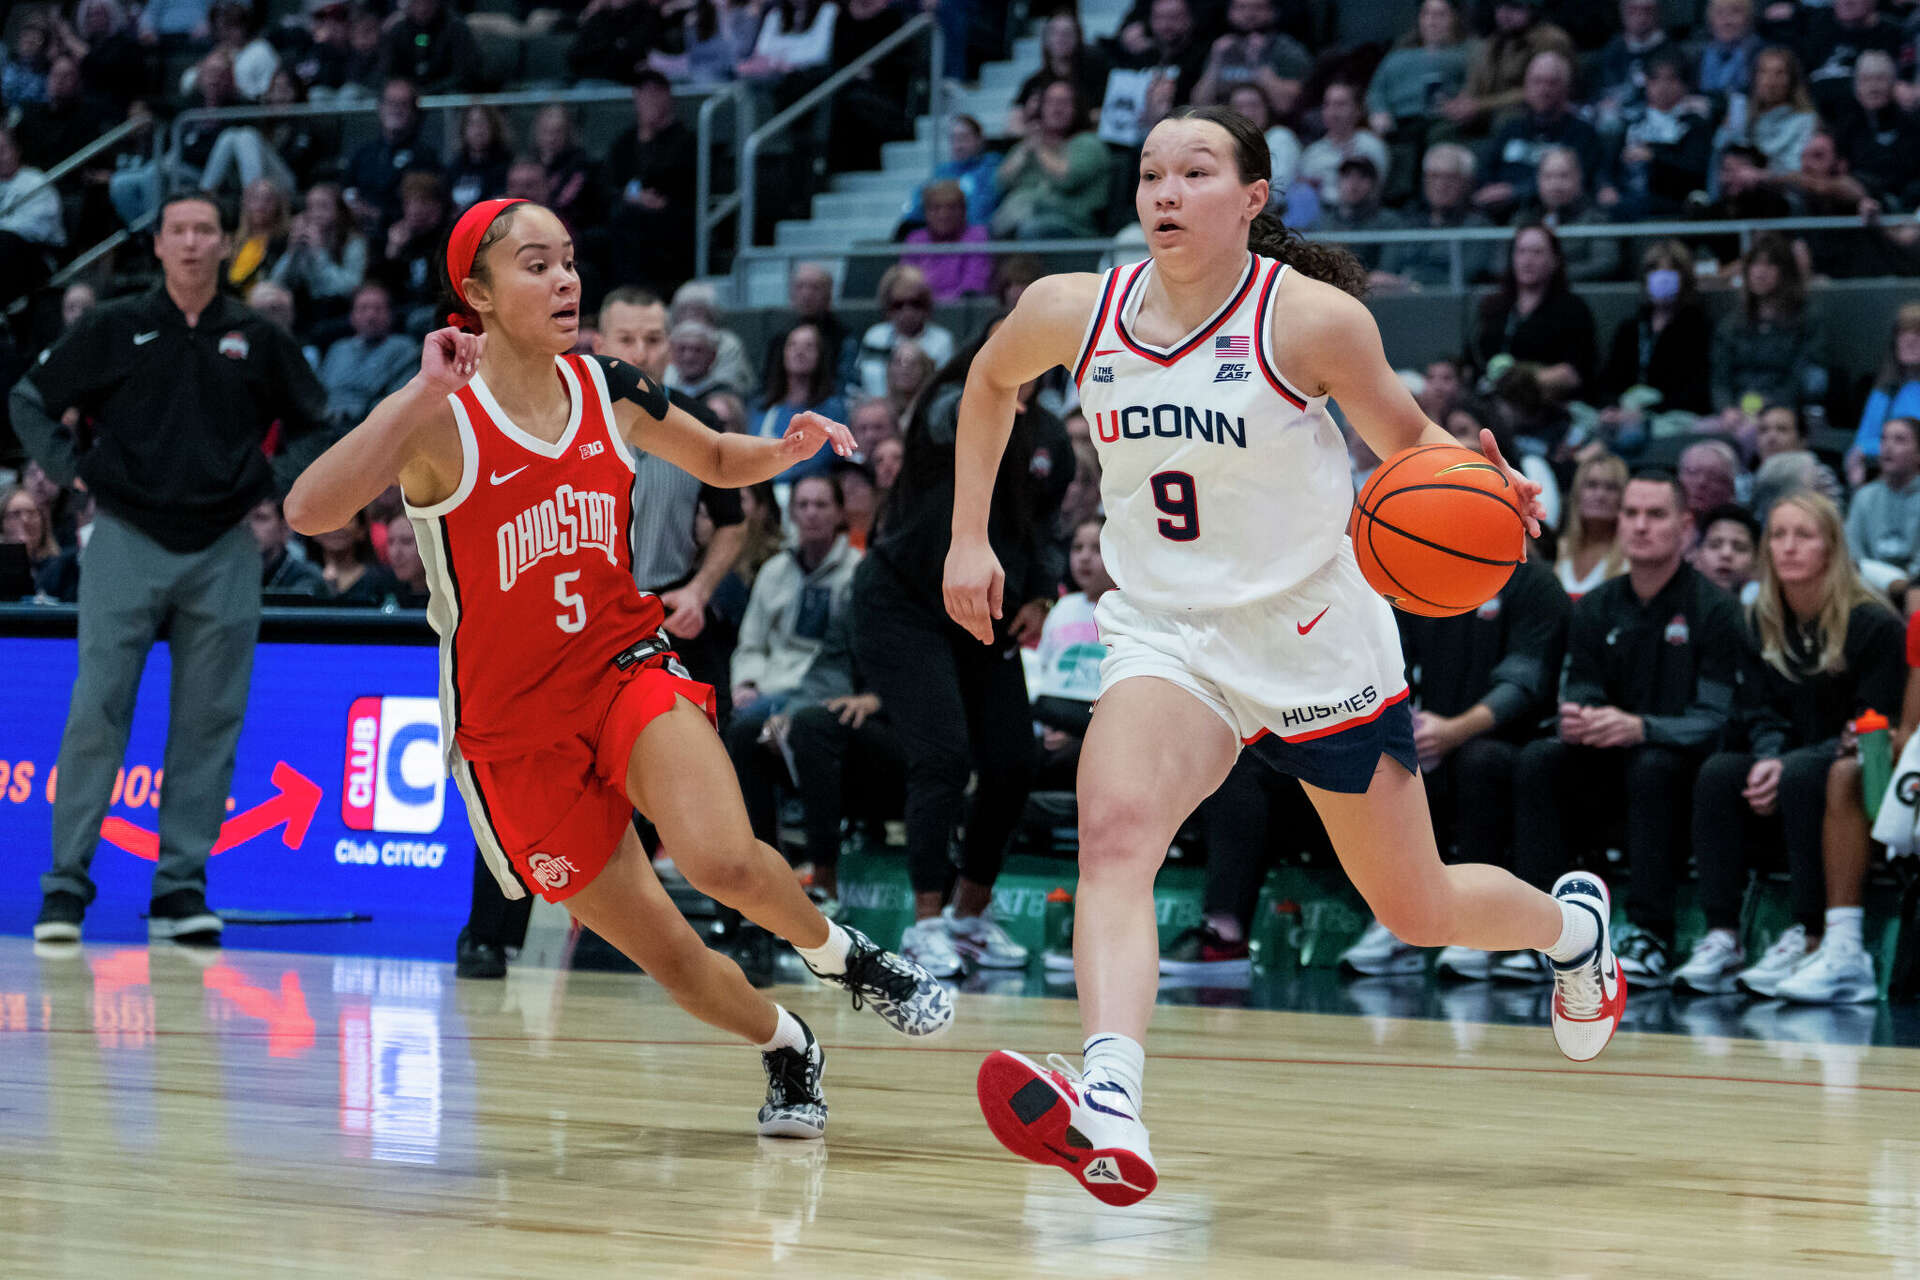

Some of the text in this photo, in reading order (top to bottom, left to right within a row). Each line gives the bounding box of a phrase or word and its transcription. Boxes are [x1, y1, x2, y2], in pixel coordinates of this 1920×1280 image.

[1098, 366, 1113, 375] THE
[1215, 371, 1252, 380] EAST
[1219, 363, 1246, 371] BIG
[1096, 404, 1247, 448] UCONN
[1150, 470, 1200, 542] 9
[497, 484, 618, 592] OHIO STATE
[554, 569, 586, 633] 5
[348, 716, 378, 808] CLUB
[385, 722, 440, 806] C
[335, 839, 447, 868] Club CITGO
